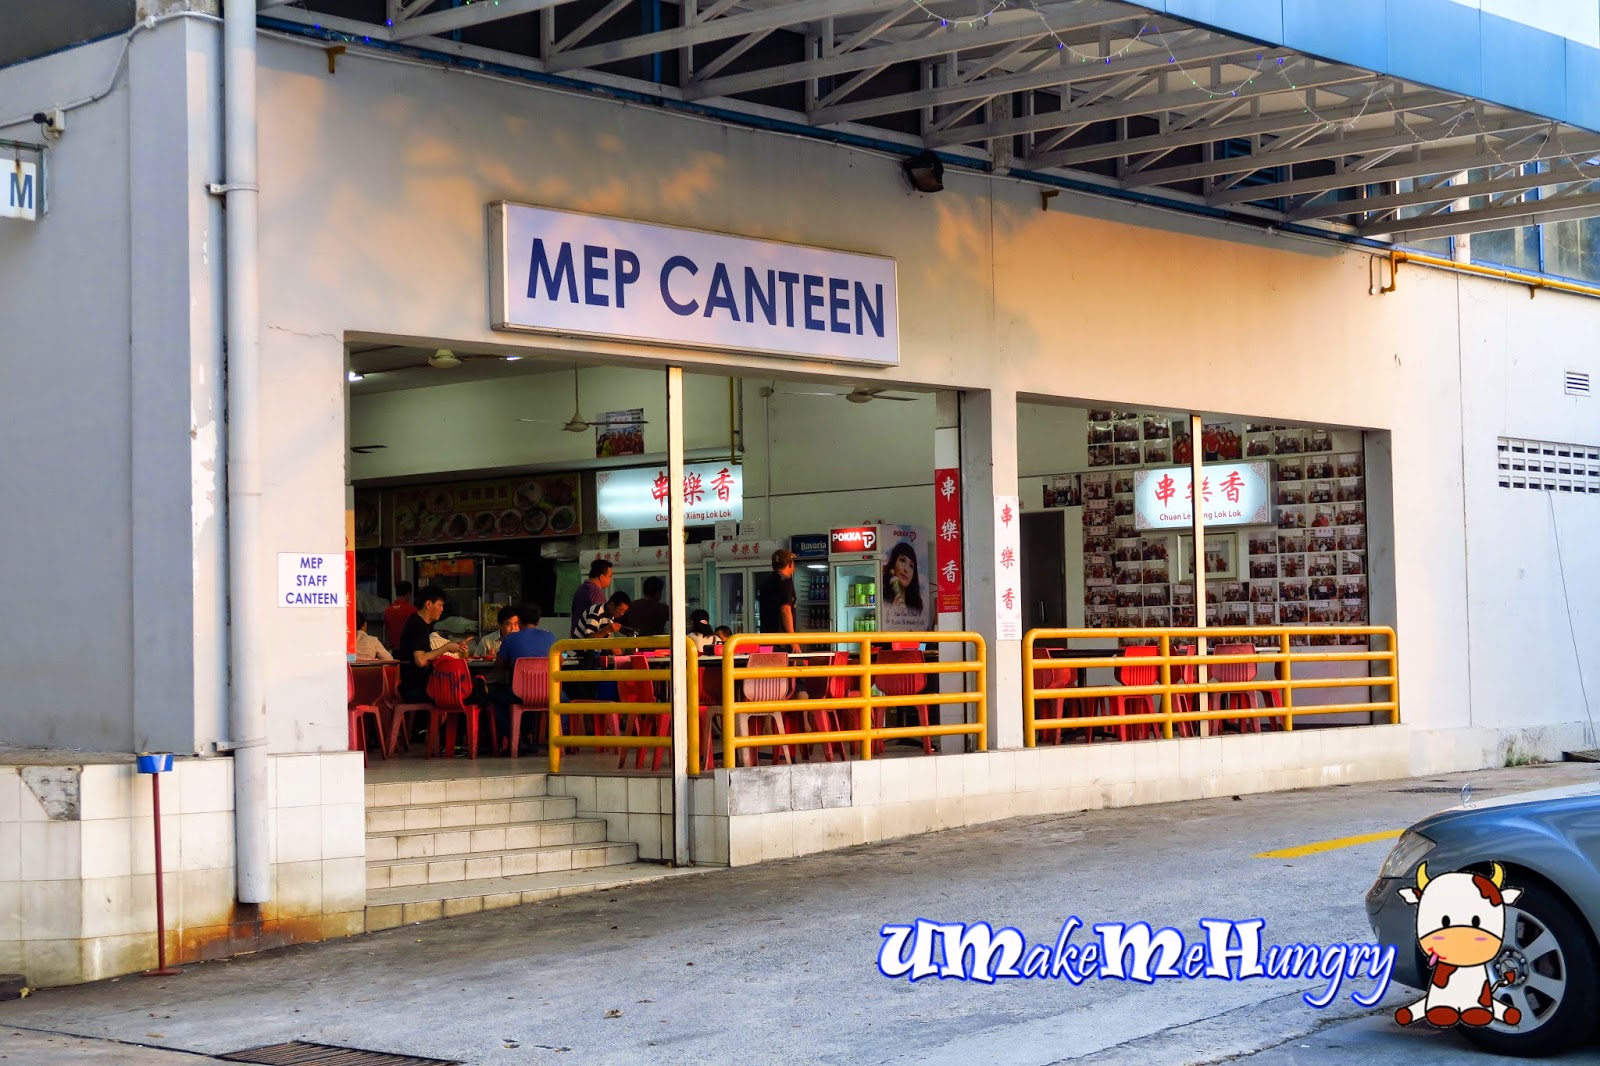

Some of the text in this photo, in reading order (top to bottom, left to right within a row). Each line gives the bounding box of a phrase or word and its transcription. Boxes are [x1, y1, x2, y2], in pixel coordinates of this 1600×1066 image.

[9, 172, 33, 209] M
[526, 238, 885, 338] MEP CANTEEN
[706, 510, 719, 519] Lok
[719, 509, 732, 518] Lok
[1214, 511, 1228, 519] Lok
[1228, 510, 1242, 518] Lok
[940, 475, 960, 584] 串樂香
[832, 532, 862, 542] POKKA
[801, 540, 827, 551] Bavaria
[300, 557, 324, 569] MEP
[999, 503, 1017, 611] 串樂香
[296, 575, 328, 587] STAFF
[285, 592, 338, 605] CANTEEN
